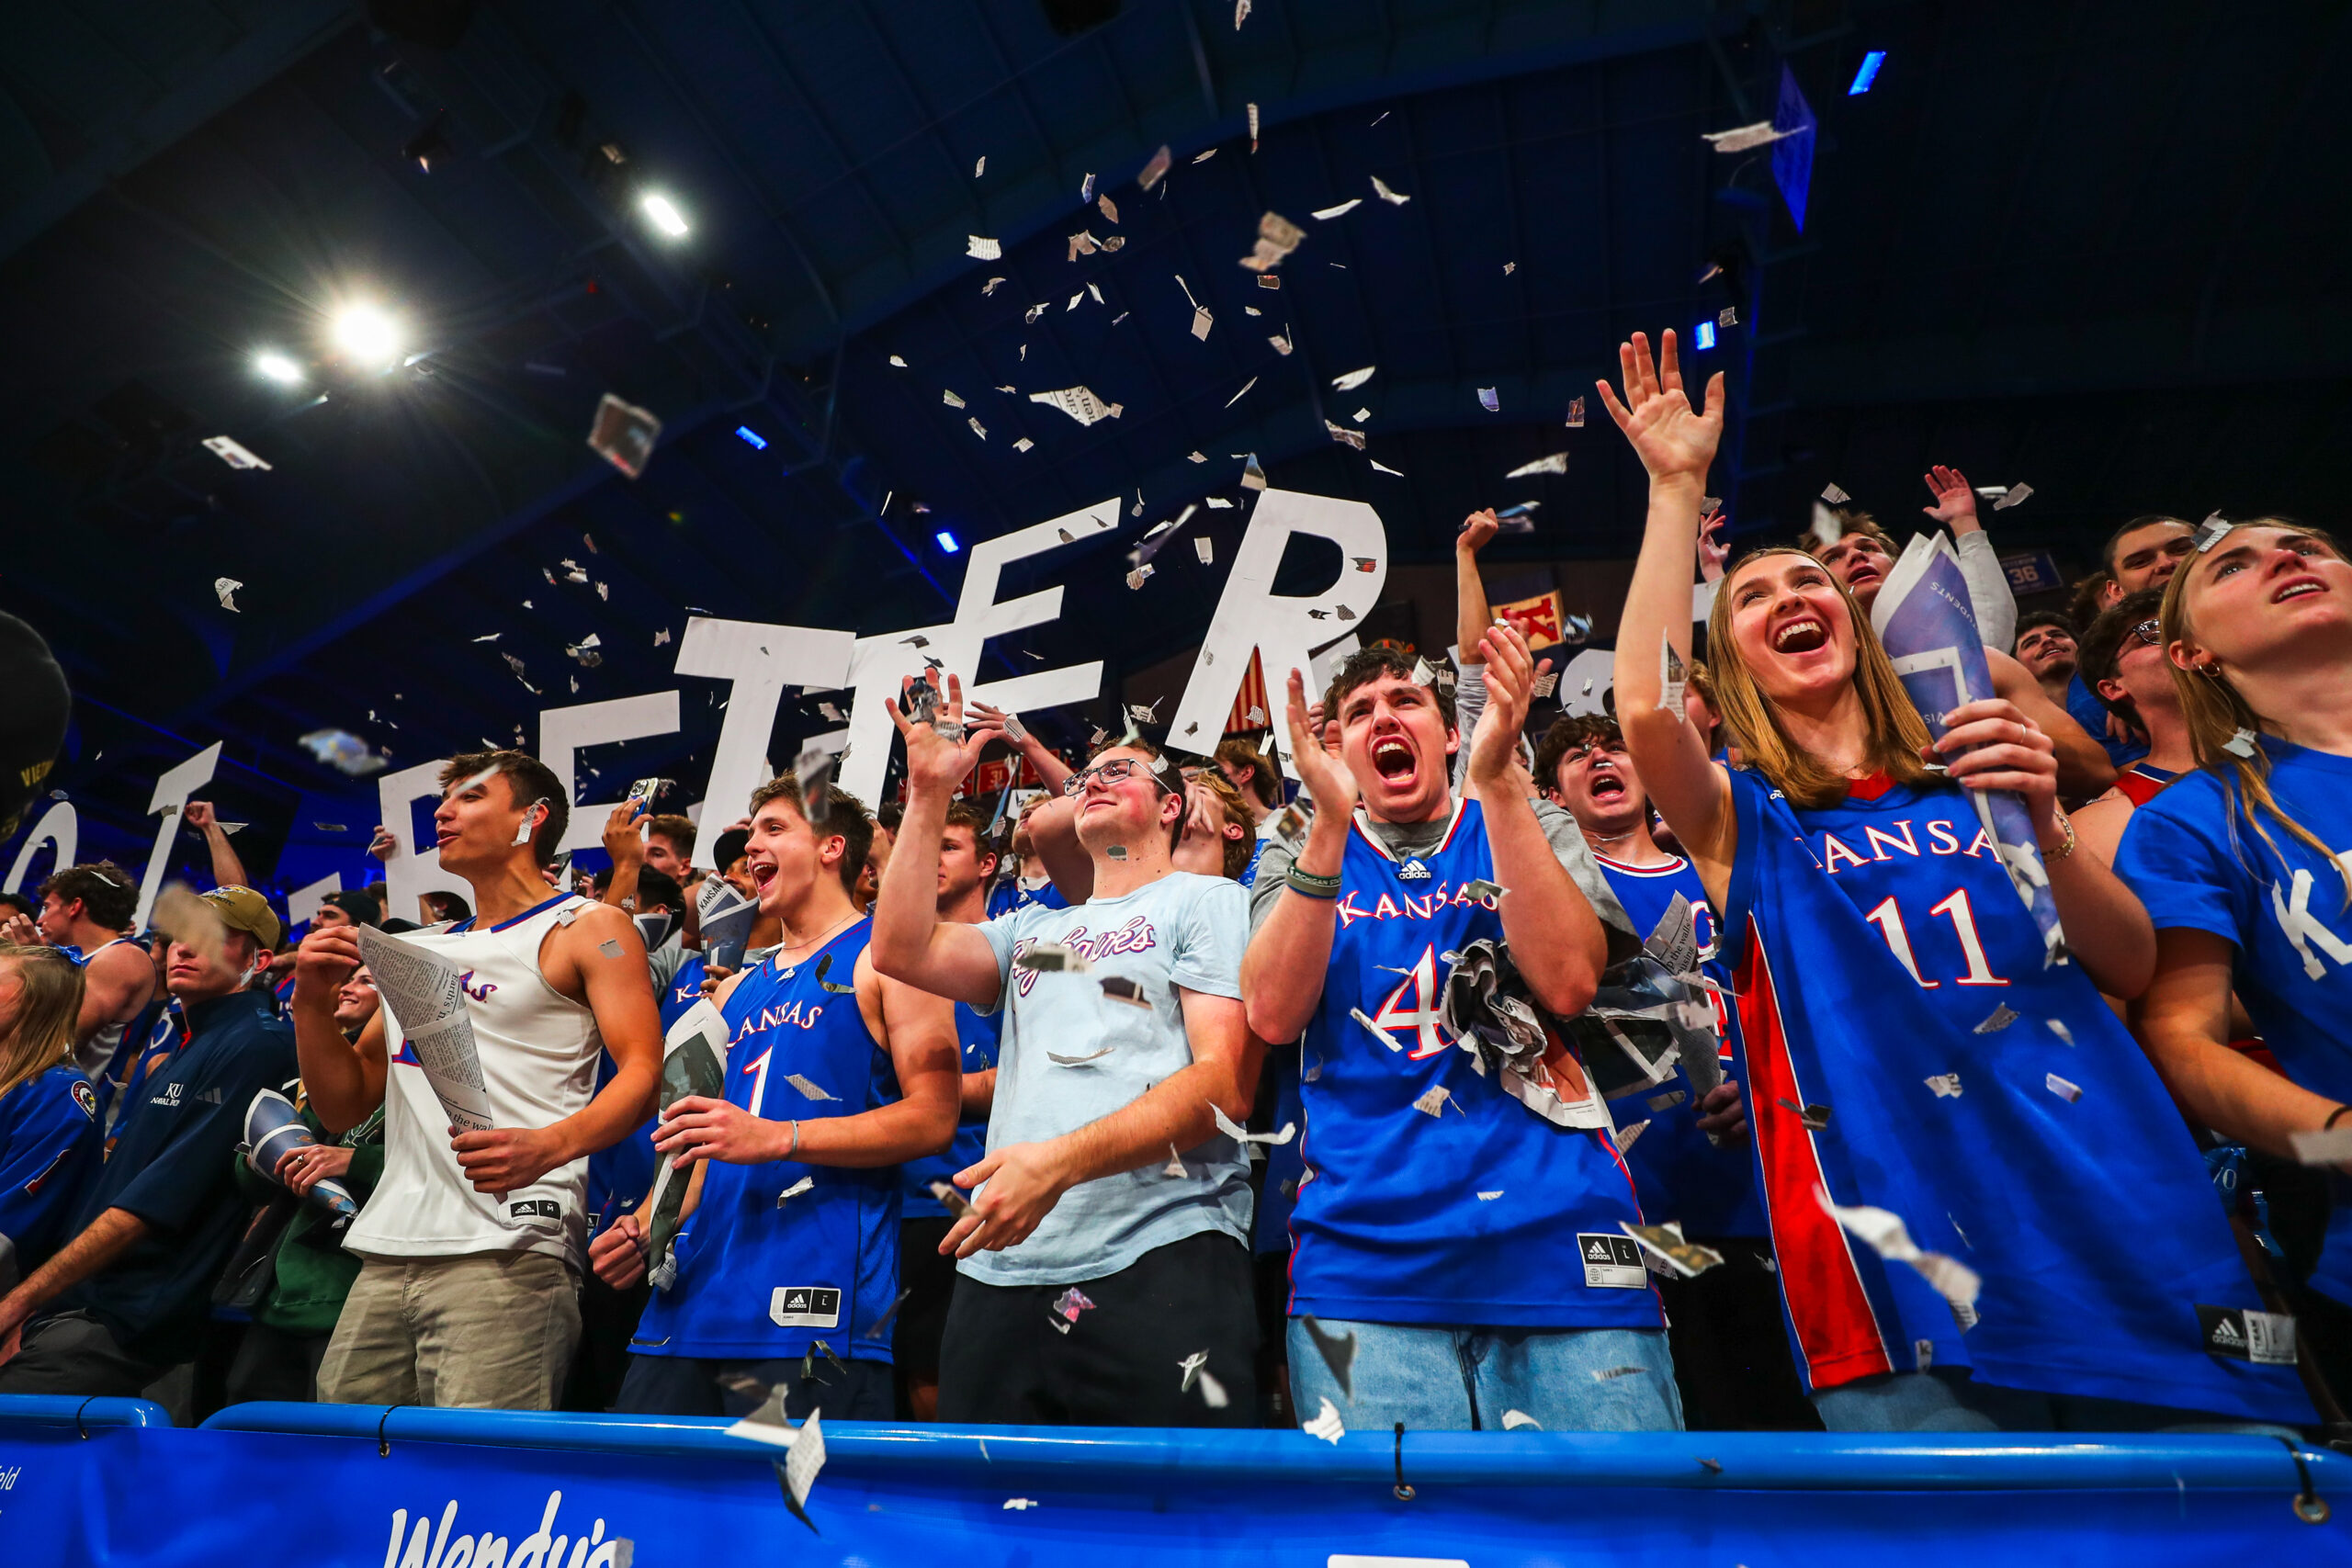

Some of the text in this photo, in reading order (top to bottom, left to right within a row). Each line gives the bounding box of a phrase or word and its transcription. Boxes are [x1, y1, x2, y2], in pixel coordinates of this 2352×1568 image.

[2008, 566, 2039, 584] 36
[1930, 581, 1978, 629] TUDENTS
[1398, 872, 1431, 880] adidas
[699, 881, 725, 911] KANSAN
[1865, 887, 2012, 989] 11
[1672, 942, 1683, 961] the
[1677, 946, 1695, 976] ousing
[443, 974, 458, 1008] Earth's
[1373, 942, 1459, 1061] 4
[725, 999, 823, 1057] ANSAS
[165, 1082, 184, 1100] KU
[454, 1112, 470, 1127] the
[1588, 1253, 1611, 1261] adidas
[1623, 1249, 1631, 1259] L
